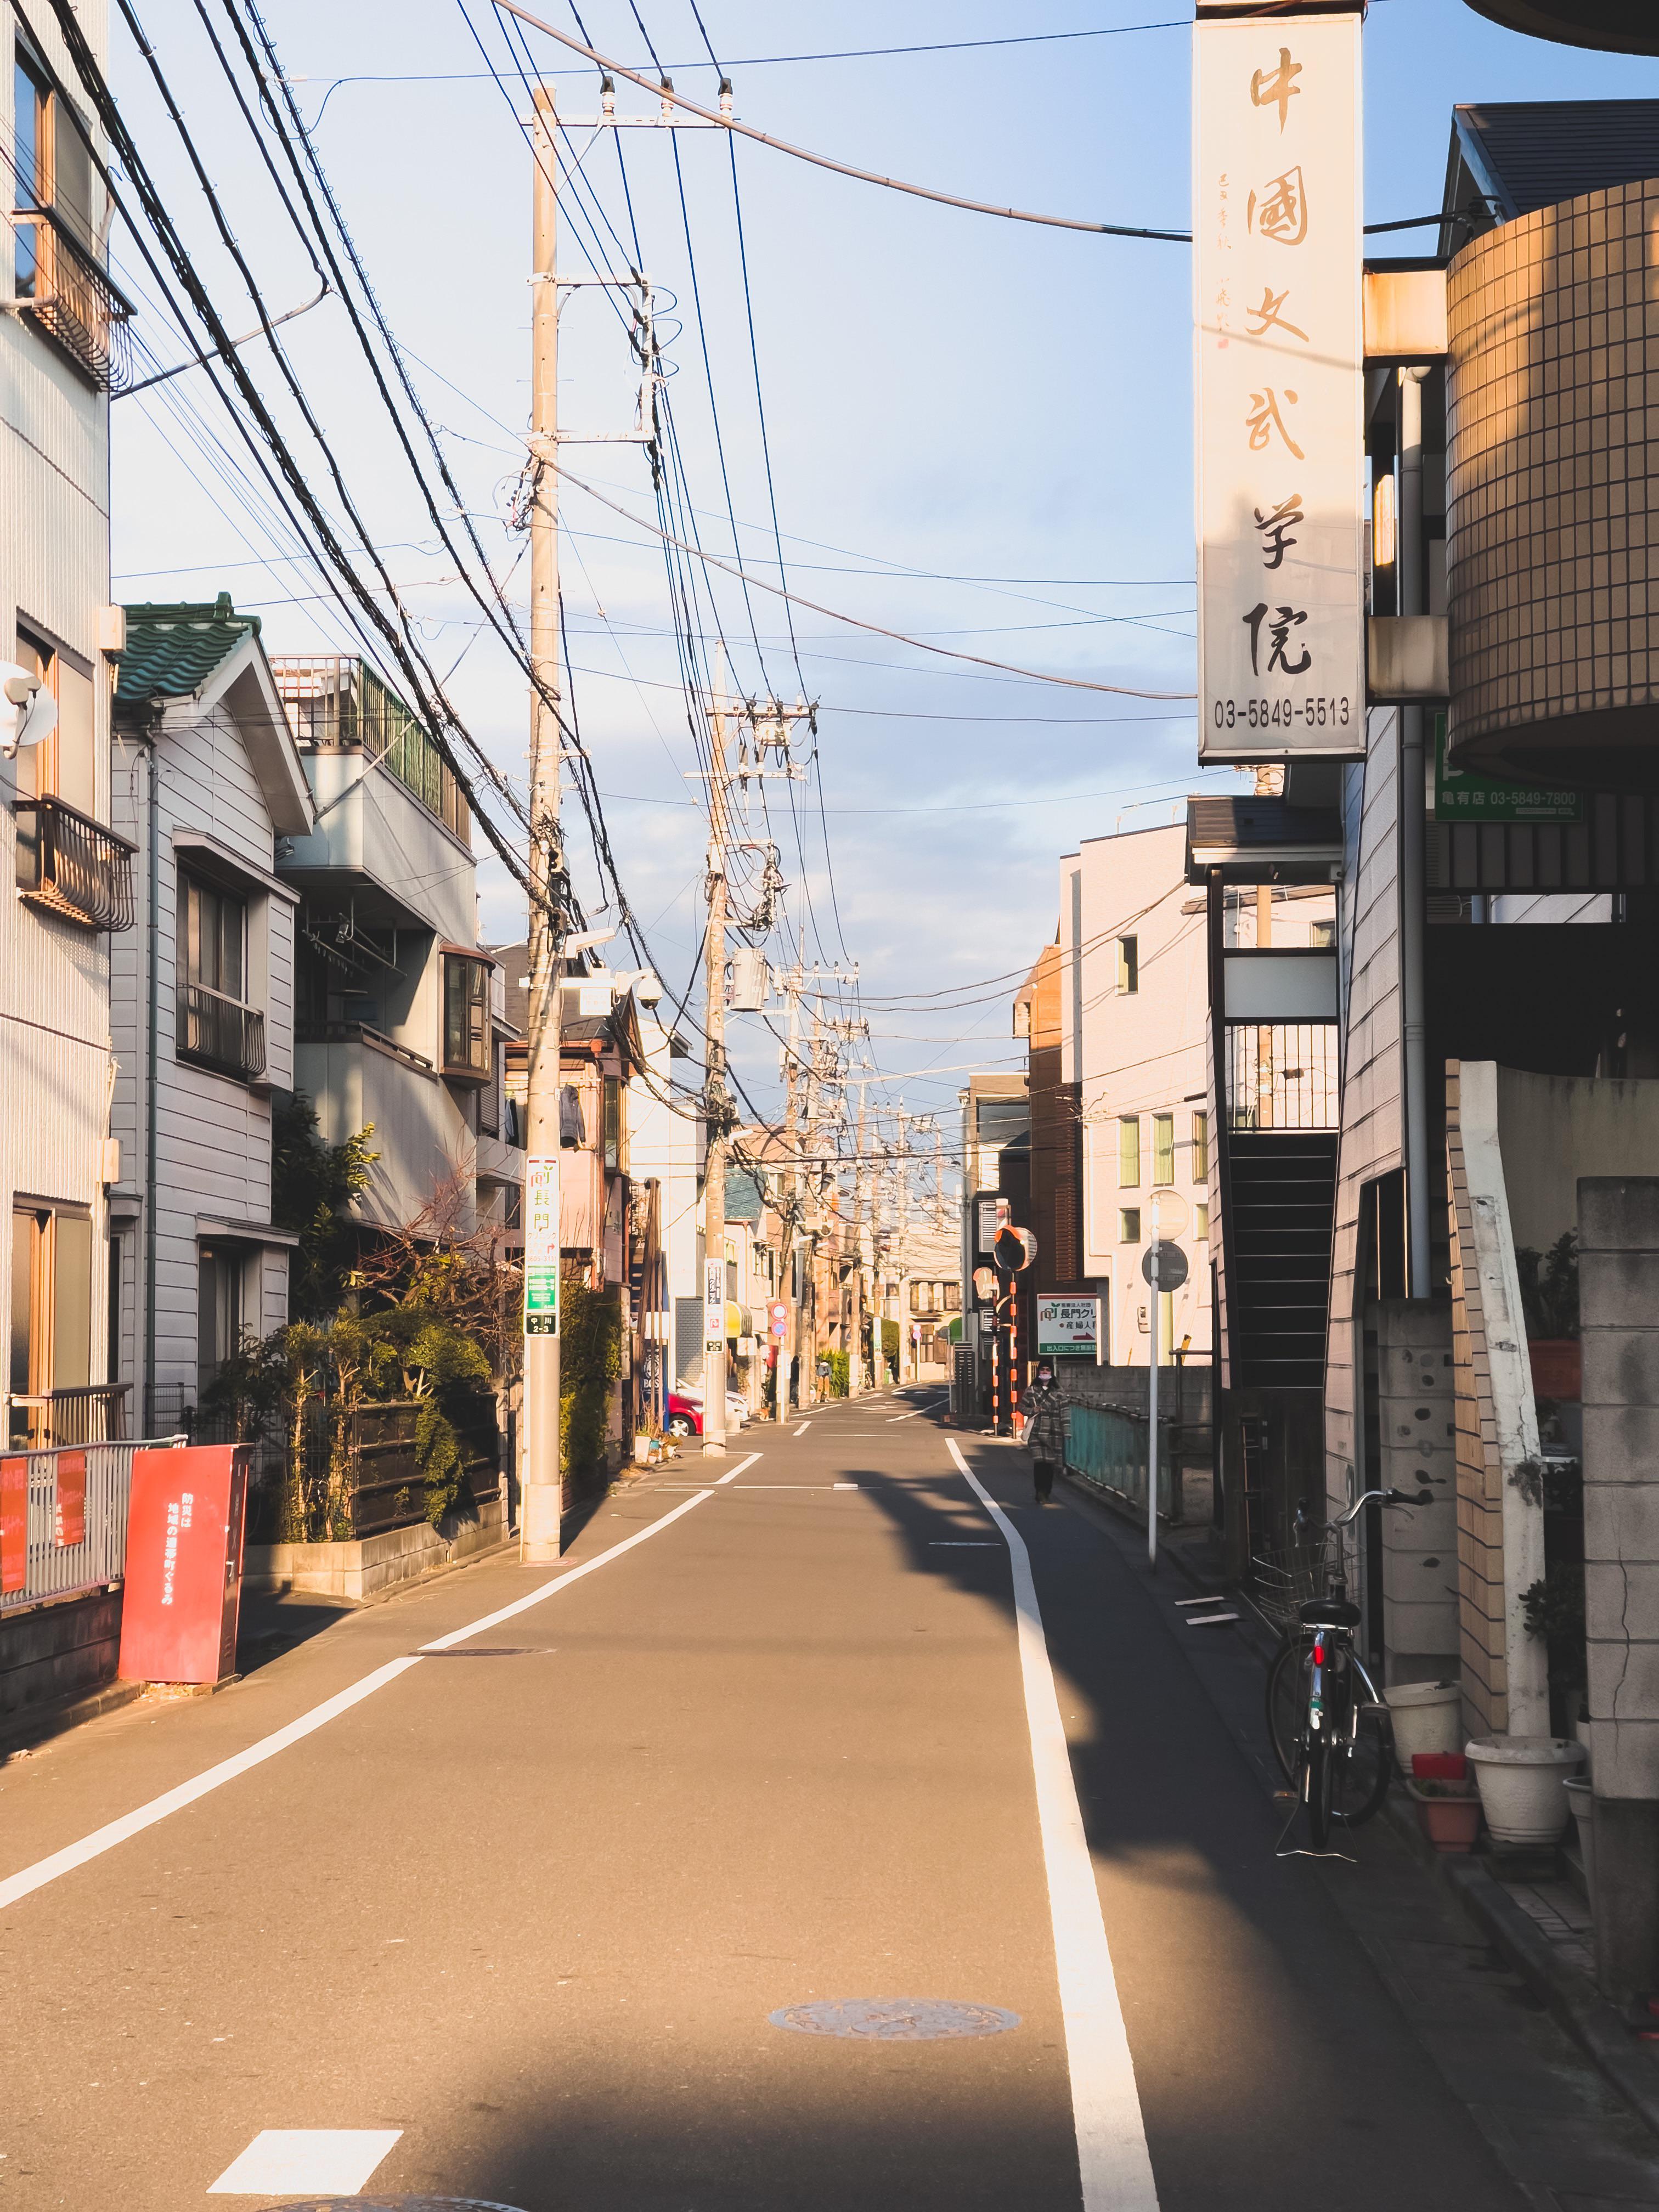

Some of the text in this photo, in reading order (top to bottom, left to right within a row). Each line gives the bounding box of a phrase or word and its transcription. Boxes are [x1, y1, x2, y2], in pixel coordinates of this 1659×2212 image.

[1214, 696, 1350, 729] 03-5849-5513
[1442, 791, 1576, 805] 亀有店 03-5849-7800
[180, 1492, 194, 1528] 防災は
